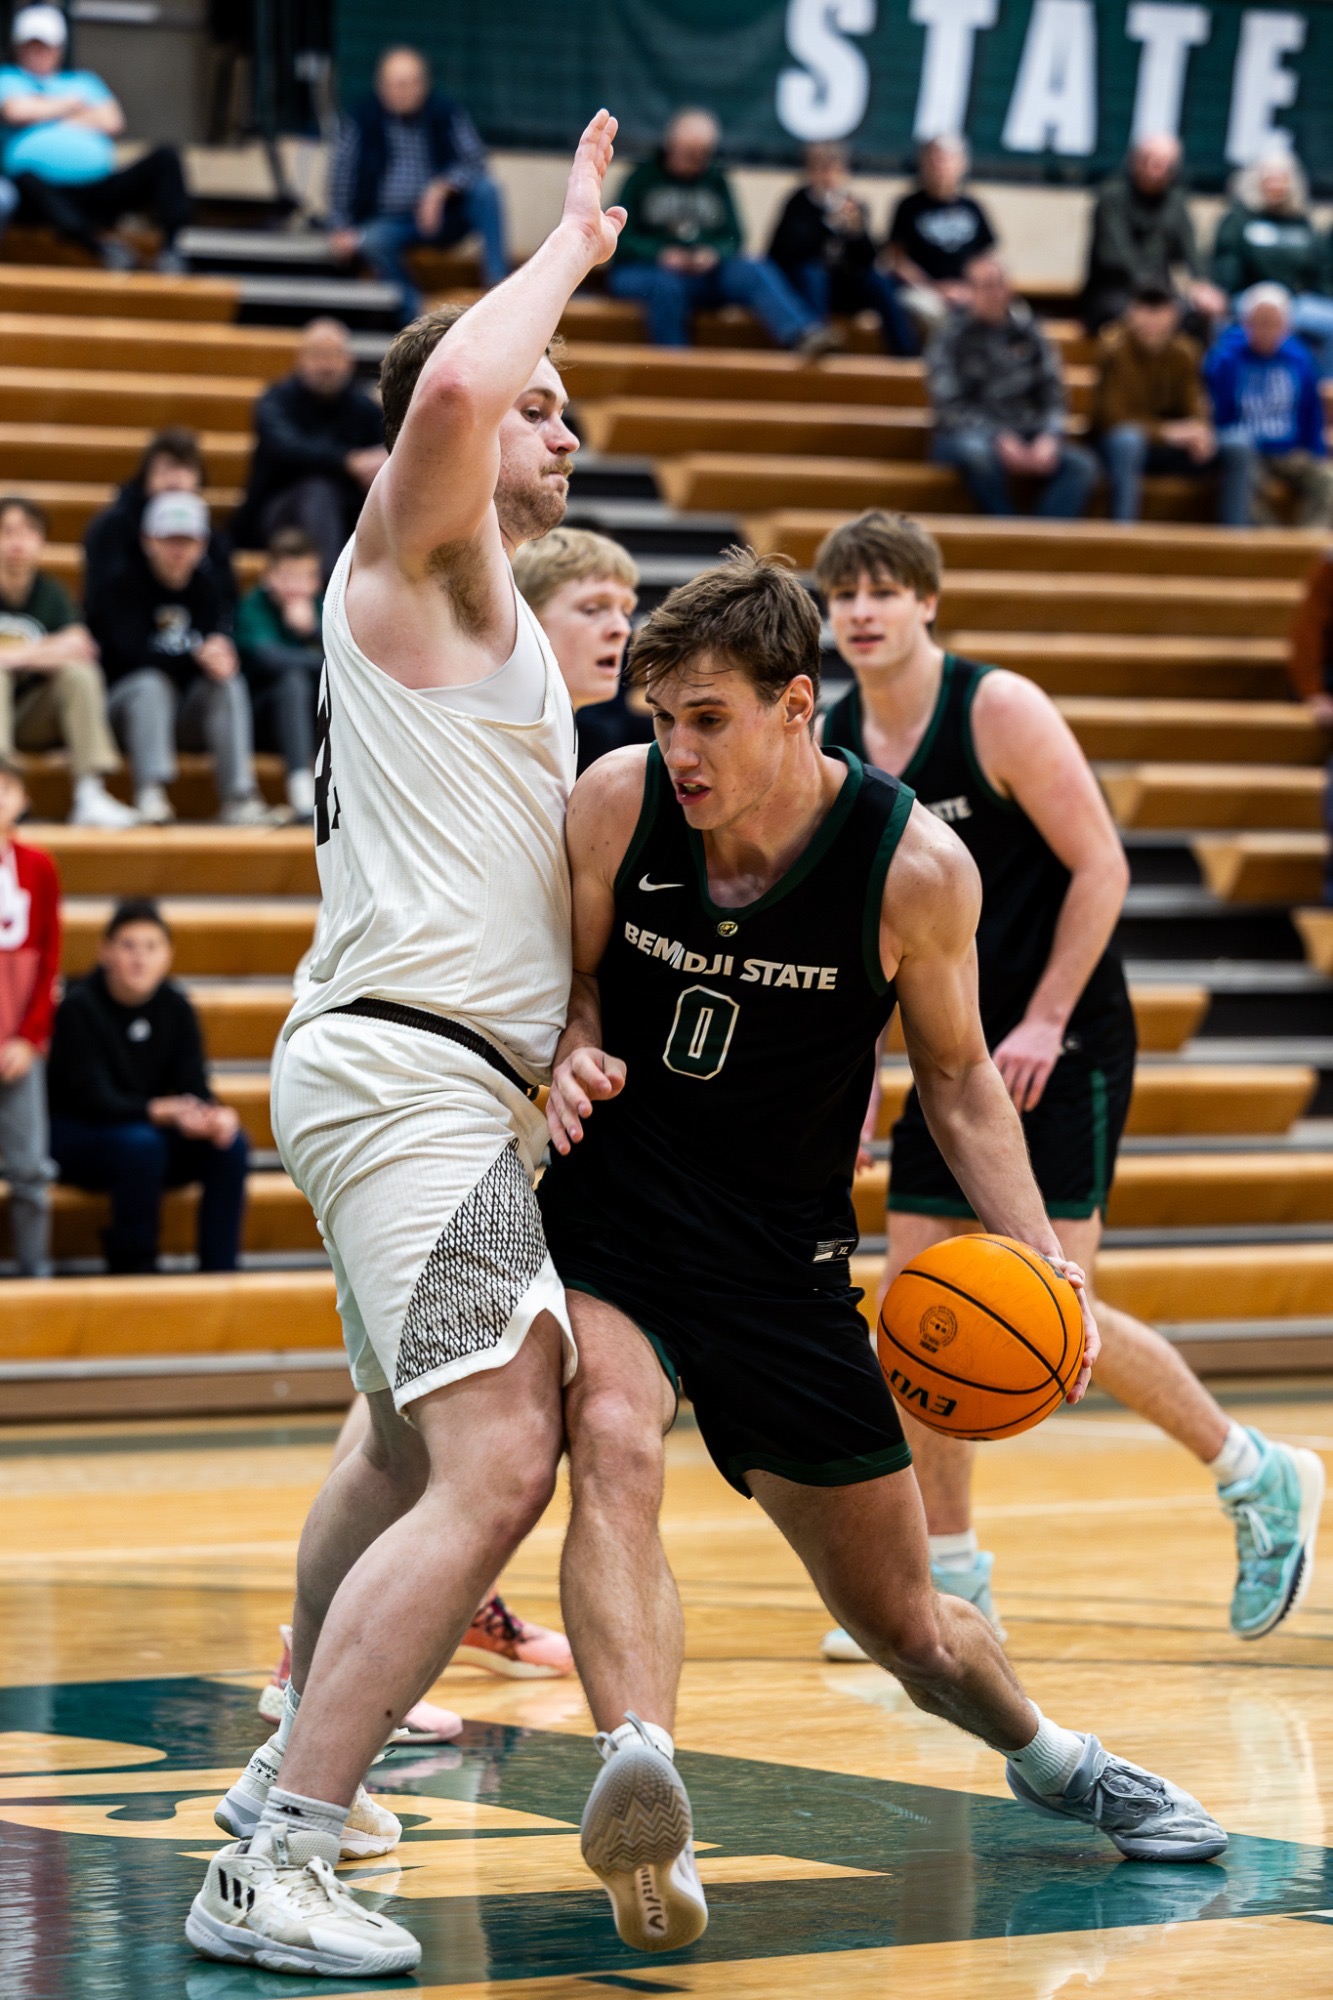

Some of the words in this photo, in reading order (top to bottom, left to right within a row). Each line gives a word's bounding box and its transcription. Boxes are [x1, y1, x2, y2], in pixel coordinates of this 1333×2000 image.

[776, 0, 1306, 166] STATE
[624, 921, 735, 977] BEMIDJI
[739, 958, 838, 990] STATE
[662, 984, 740, 1081] 0
[889, 1368, 958, 1418] EVO
